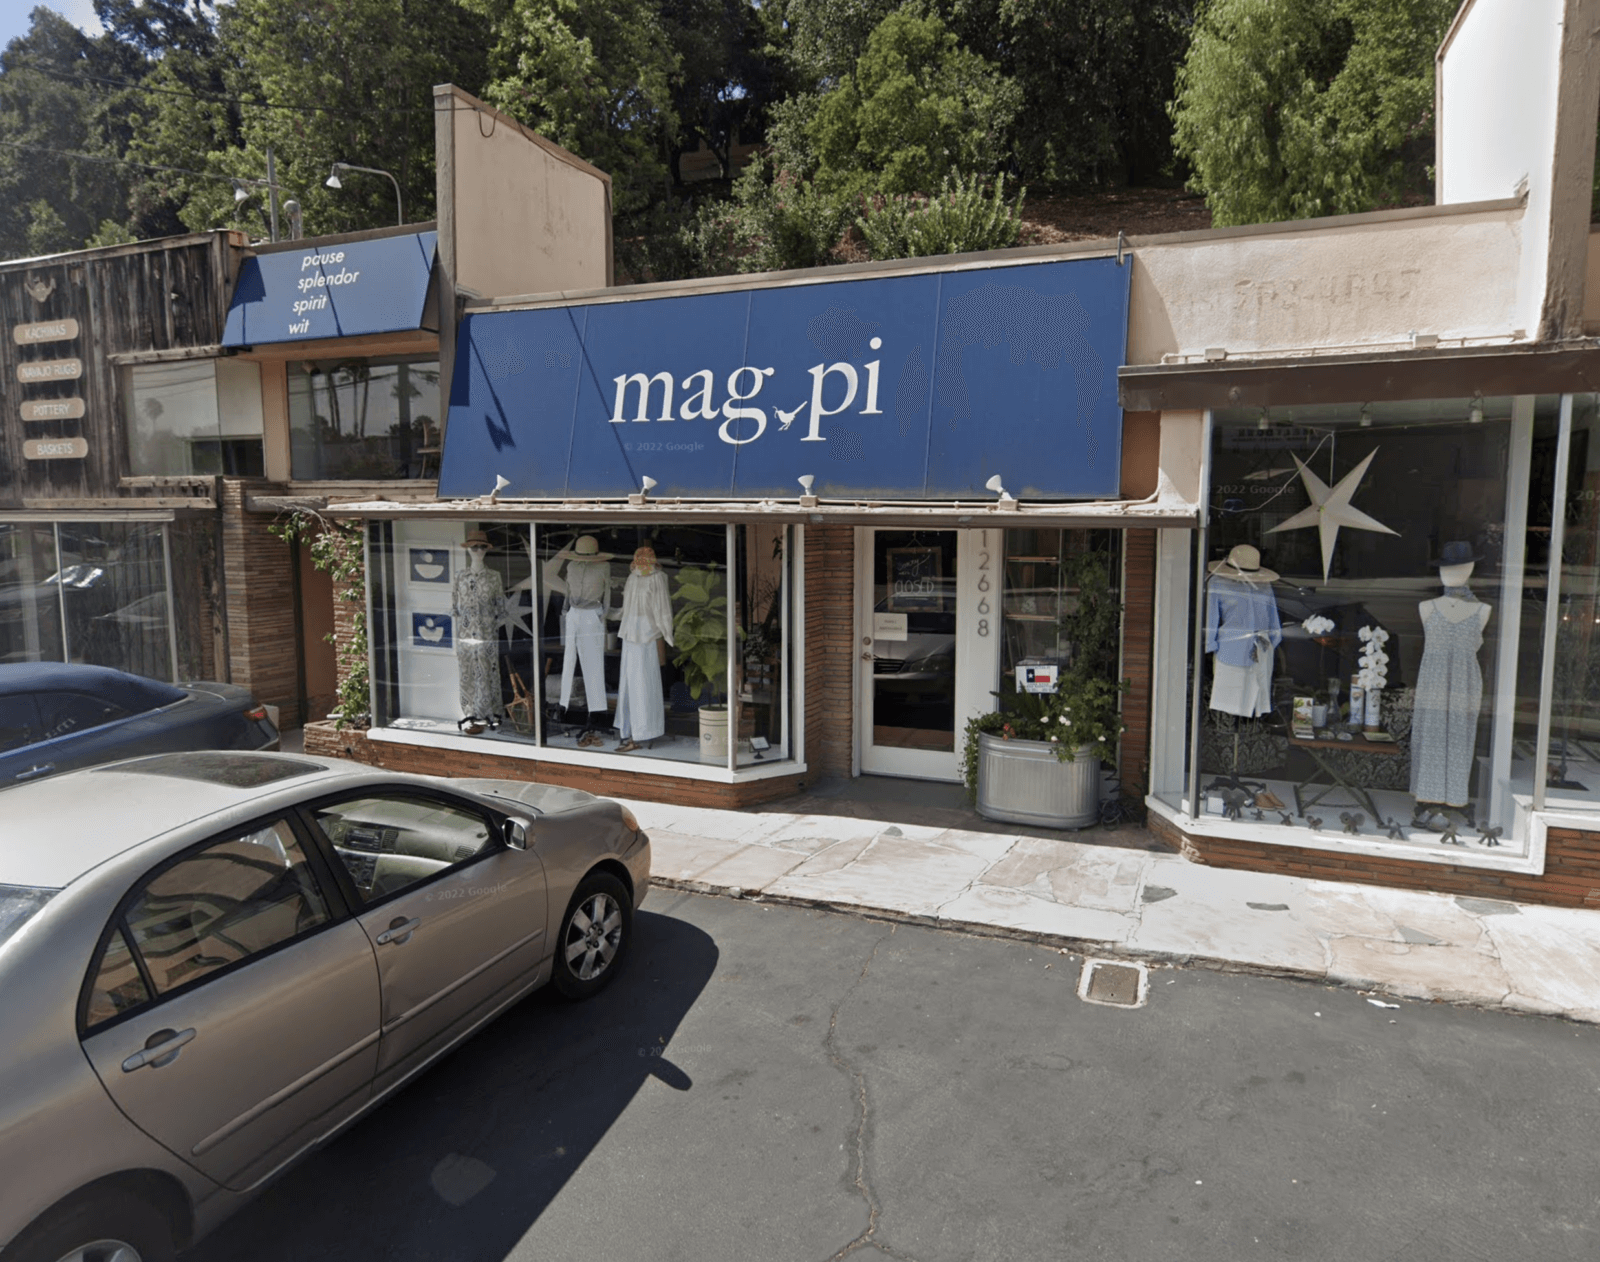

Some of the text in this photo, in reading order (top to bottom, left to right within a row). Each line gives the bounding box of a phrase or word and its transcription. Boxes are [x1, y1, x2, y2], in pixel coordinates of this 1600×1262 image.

[301, 251, 345, 271] pause
[298, 267, 360, 293] splendor
[292, 294, 327, 316] spirit
[24, 324, 67, 340] KACHINAS
[289, 319, 309, 334] wit
[21, 363, 77, 379] NAVAJO RUGS
[608, 337, 883, 445] mag pi
[33, 403, 70, 417] POTTERY
[37, 442, 74, 456] BASKETS
[894, 580, 935, 595] CLOSED
[977, 529, 991, 637] 12668
